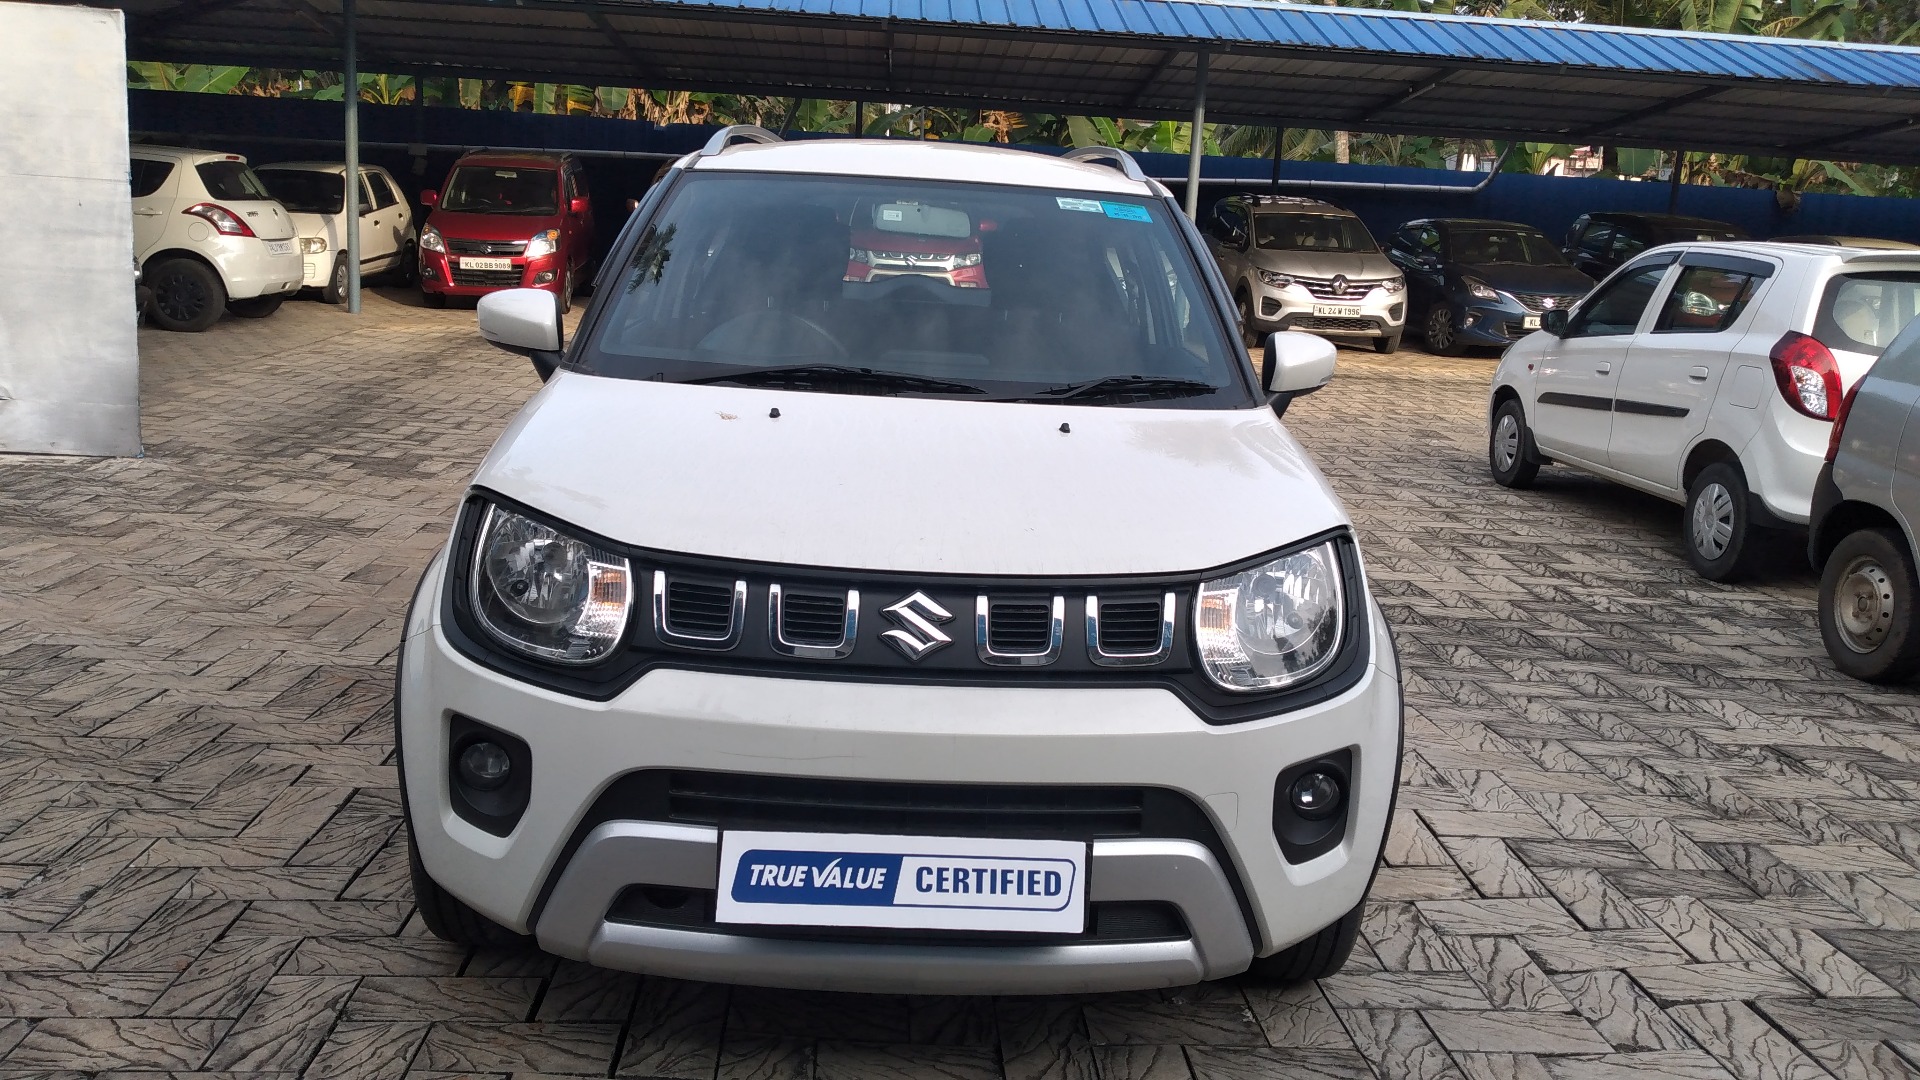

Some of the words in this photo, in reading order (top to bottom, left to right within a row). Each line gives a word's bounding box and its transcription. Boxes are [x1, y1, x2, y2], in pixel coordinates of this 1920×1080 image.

[1318, 306, 1327, 315] KL
[750, 864, 808, 888] TRUE
[811, 857, 888, 890] VALUE
[915, 865, 1062, 897] CERTIFIED
